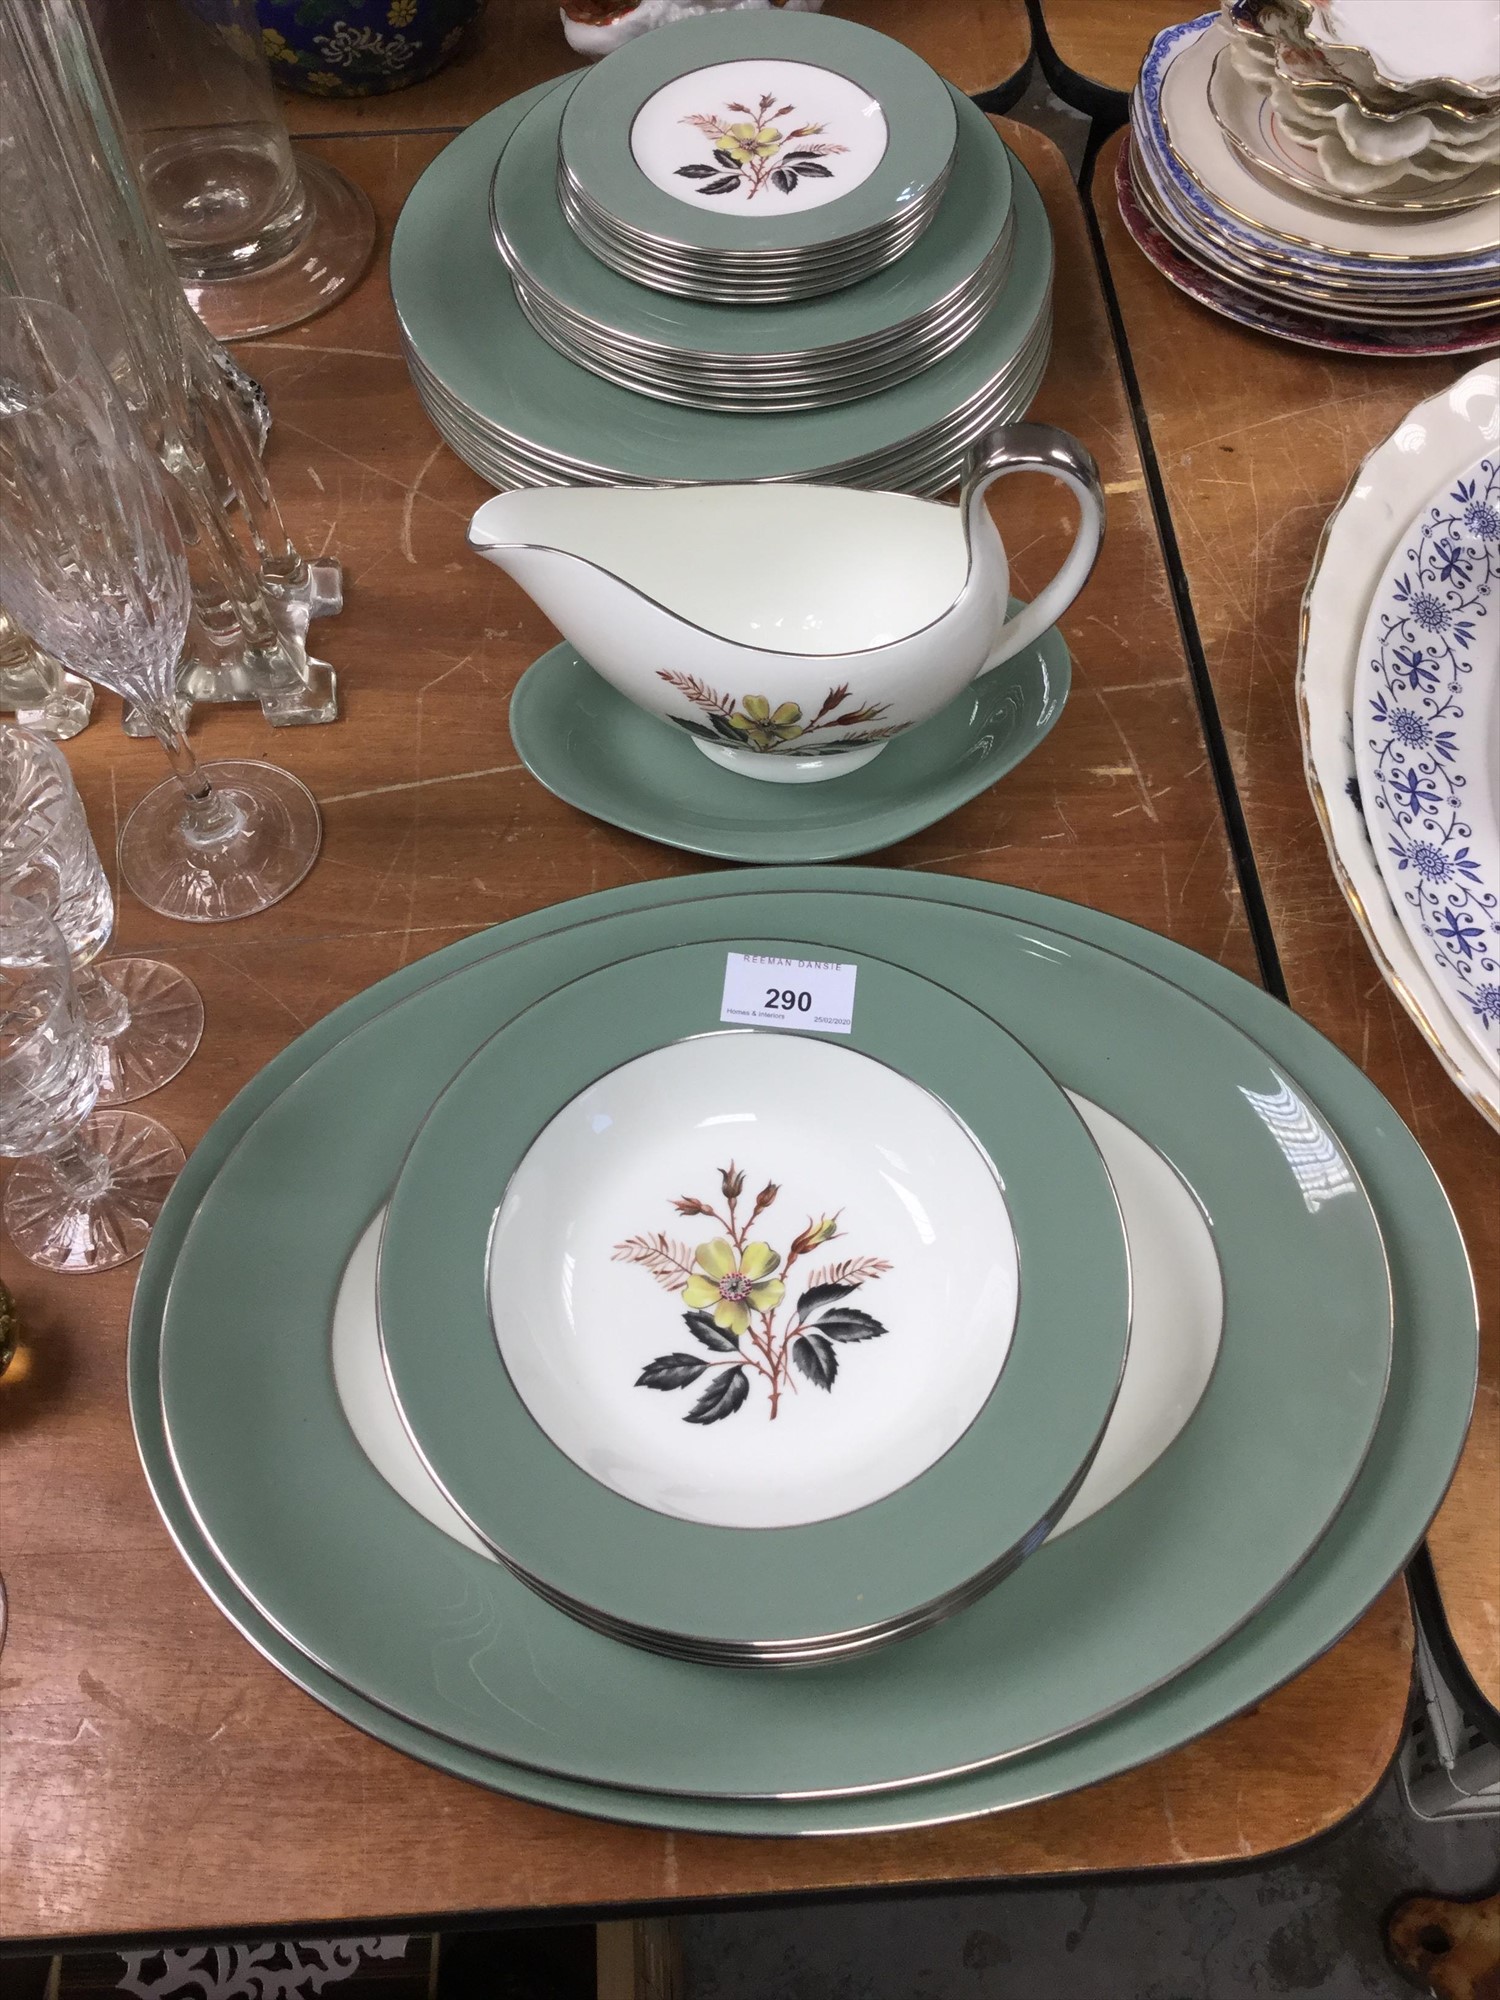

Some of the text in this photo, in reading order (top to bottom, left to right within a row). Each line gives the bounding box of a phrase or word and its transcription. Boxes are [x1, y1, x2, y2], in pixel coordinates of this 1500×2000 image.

[743, 954, 842, 971] REEMAN DANSIE
[764, 988, 812, 1012] 290
[727, 1008, 750, 1017] Homes
[814, 1016, 851, 1026] 25/02/2020
